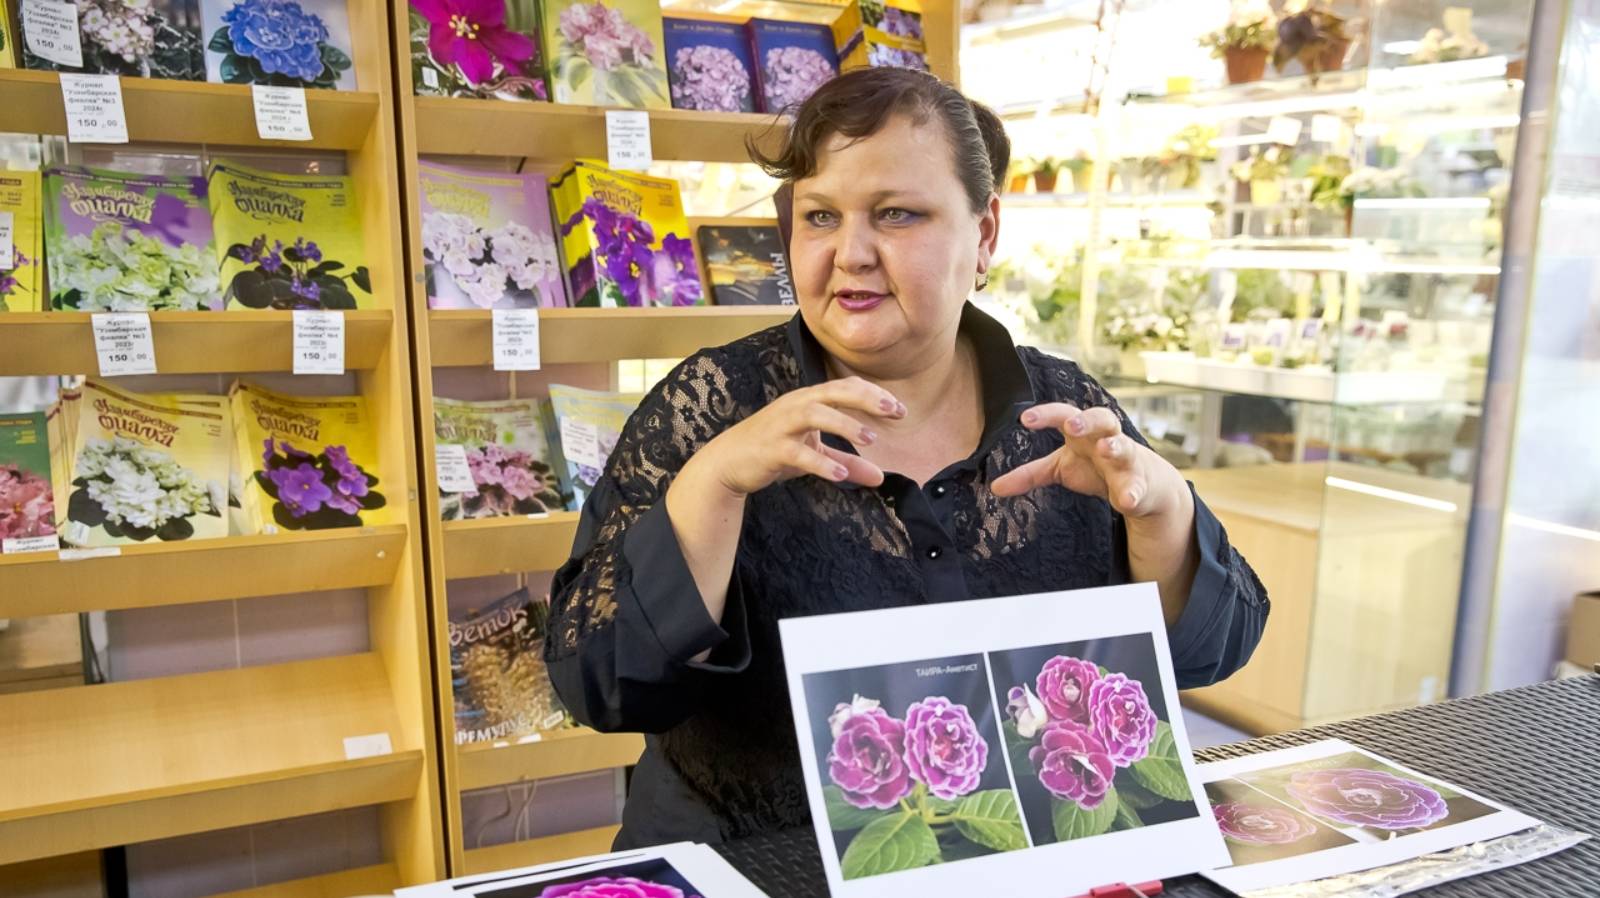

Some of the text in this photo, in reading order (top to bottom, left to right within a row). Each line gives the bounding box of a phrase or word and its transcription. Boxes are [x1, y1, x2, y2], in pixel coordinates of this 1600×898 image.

[36, 38, 55, 49] 150
[78, 118, 98, 128] 150
[108, 353, 128, 362] 150
[303, 352, 321, 360] 150
